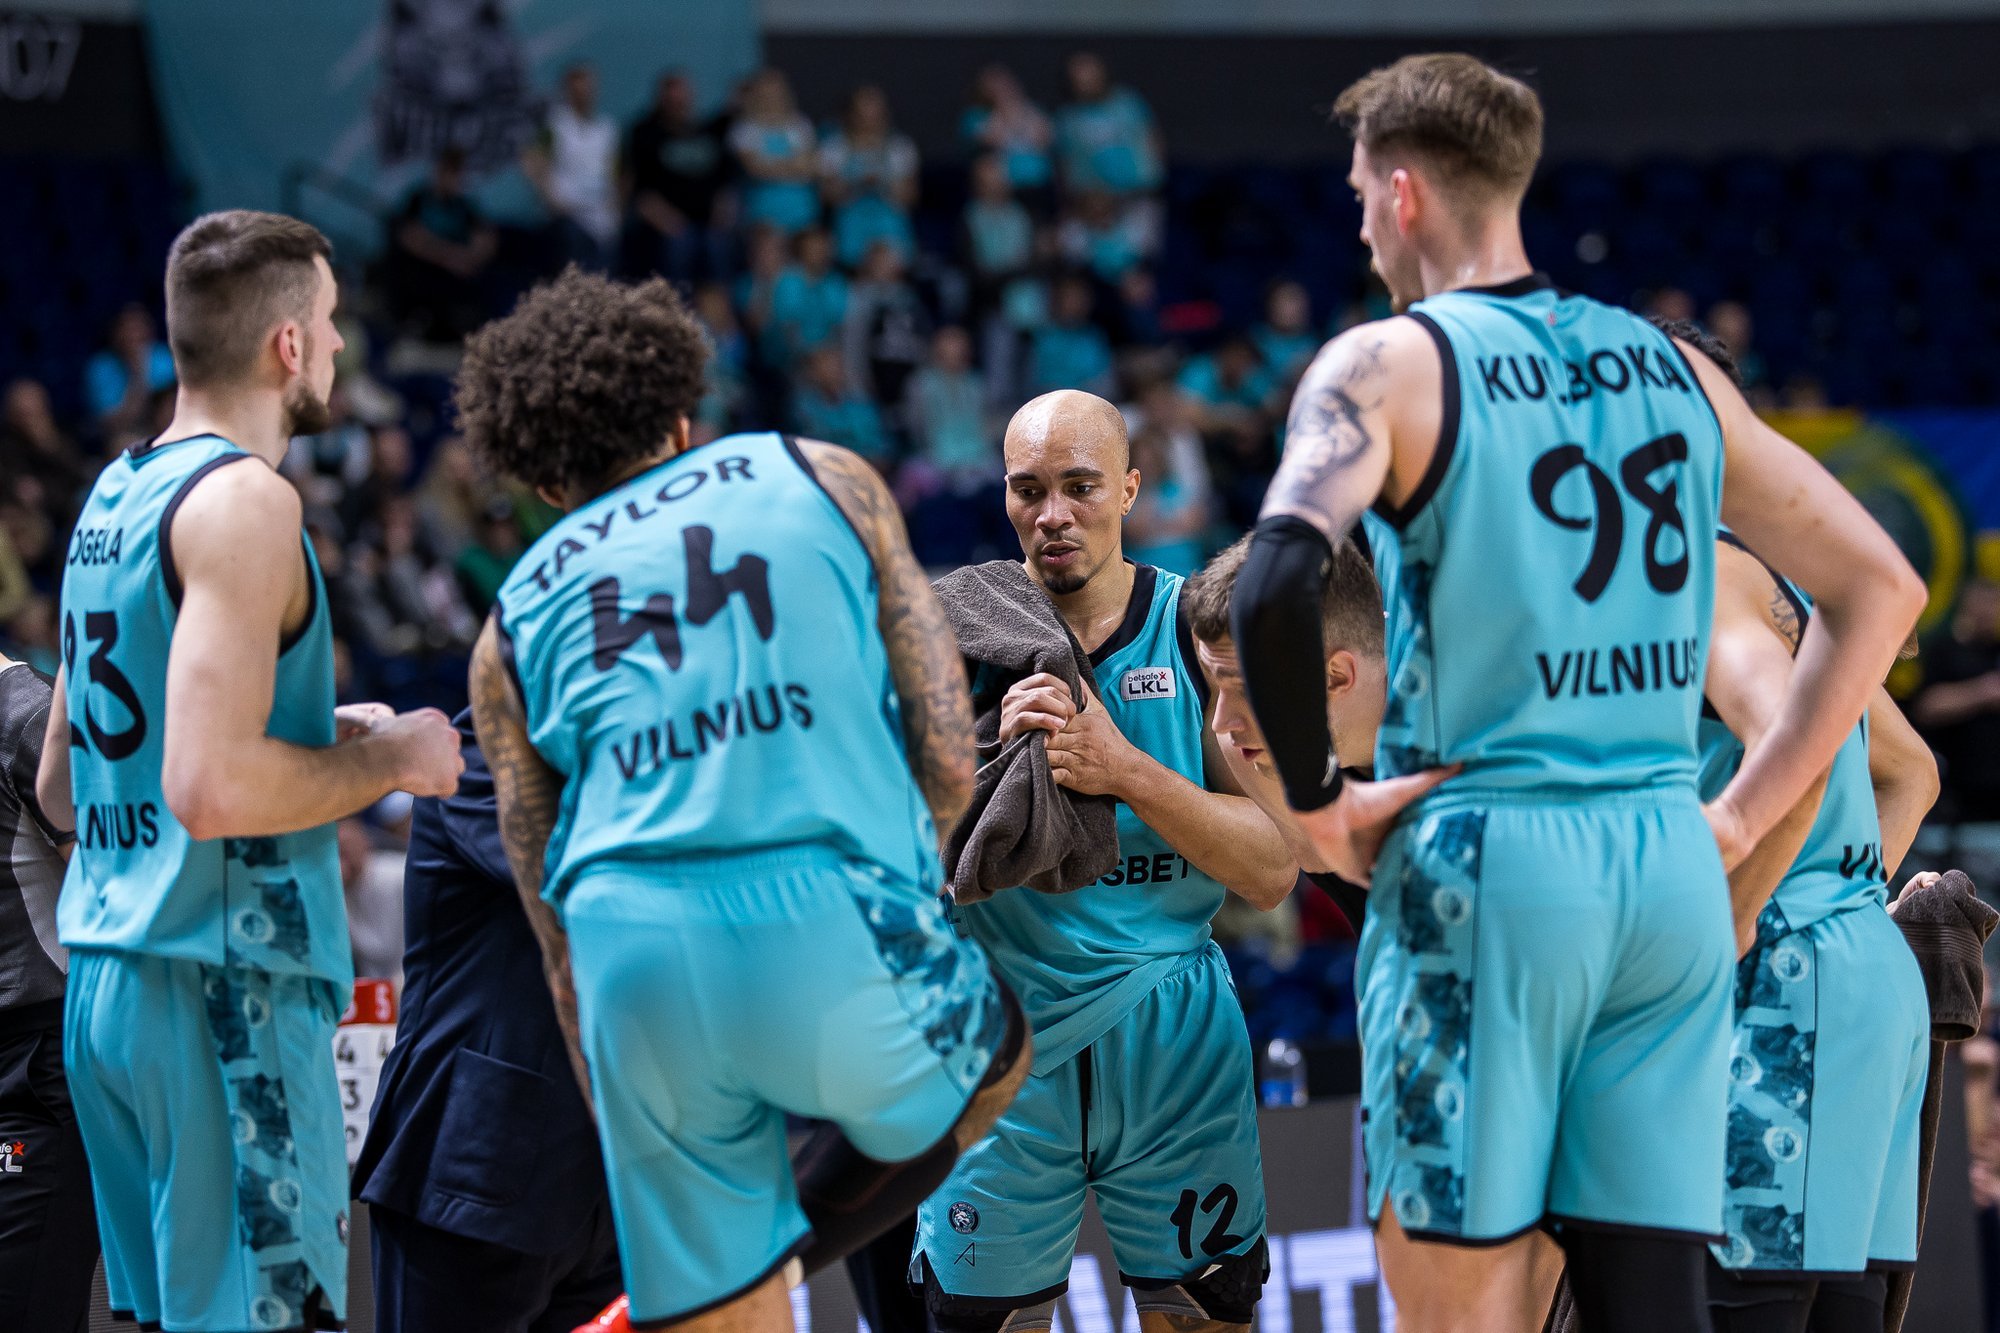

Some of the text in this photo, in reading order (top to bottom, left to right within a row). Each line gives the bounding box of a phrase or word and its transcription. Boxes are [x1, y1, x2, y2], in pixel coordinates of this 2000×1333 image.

[528, 456, 756, 592] TAYLOR
[1530, 432, 1690, 602] 98
[588, 524, 774, 672] 44
[1128, 673, 1159, 682] betsafe
[1128, 680, 1169, 695] LKL
[1535, 638, 1698, 699] VILNIUS
[613, 682, 813, 782] VILNIUS
[74, 802, 160, 849] NIUS
[1088, 852, 1189, 886] SBET
[1169, 1182, 1246, 1260] 12
